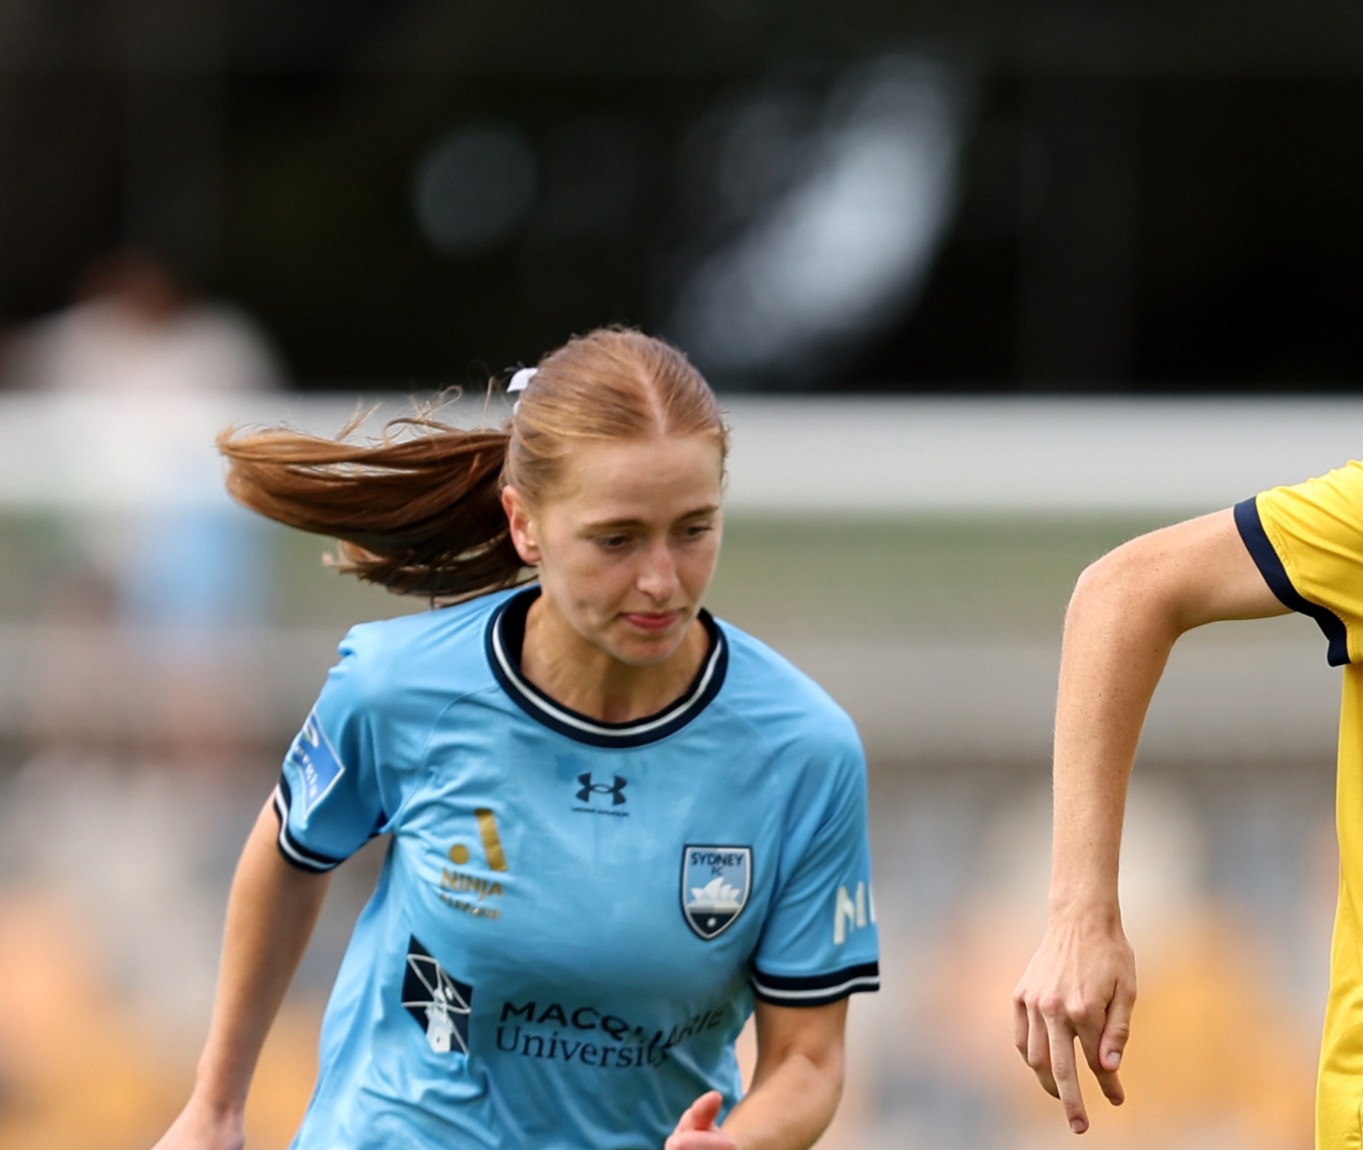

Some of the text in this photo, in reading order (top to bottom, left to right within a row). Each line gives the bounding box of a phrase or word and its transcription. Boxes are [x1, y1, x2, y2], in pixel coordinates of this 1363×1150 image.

[691, 852, 744, 866] SYDNEY
[711, 867, 724, 876] FC
[440, 866, 505, 900] NINJA
